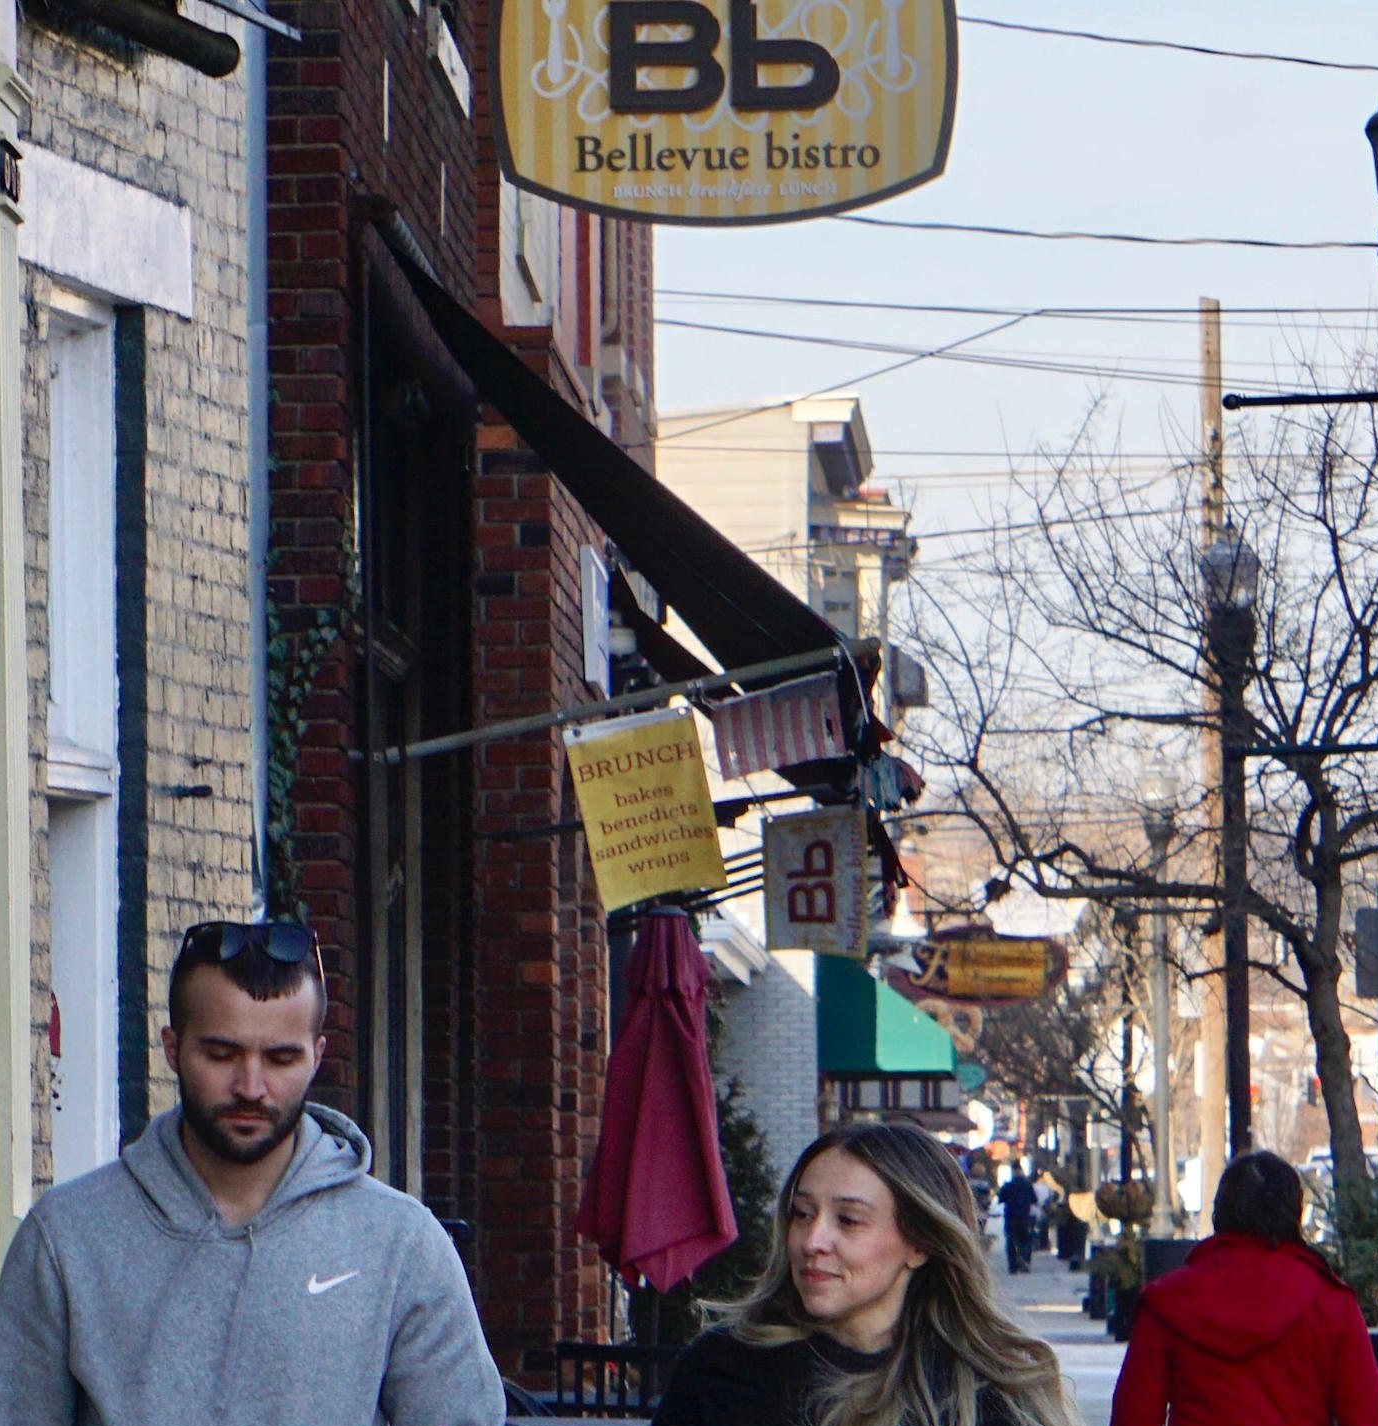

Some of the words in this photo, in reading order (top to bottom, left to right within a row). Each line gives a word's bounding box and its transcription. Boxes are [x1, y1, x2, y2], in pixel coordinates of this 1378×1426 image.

[610, 0, 840, 112] Bb
[575, 132, 749, 172] Bellevue
[765, 130, 881, 170] bistro
[613, 184, 683, 199] BRUNCH
[688, 180, 771, 203] breakfast
[779, 182, 838, 198] LUNCH
[577, 740, 696, 783] BRUNCH
[613, 784, 674, 808] bakes
[600, 803, 698, 836] benedicts
[595, 824, 714, 862] sandwiches
[628, 850, 690, 874] wraps
[786, 839, 836, 923] Bb
